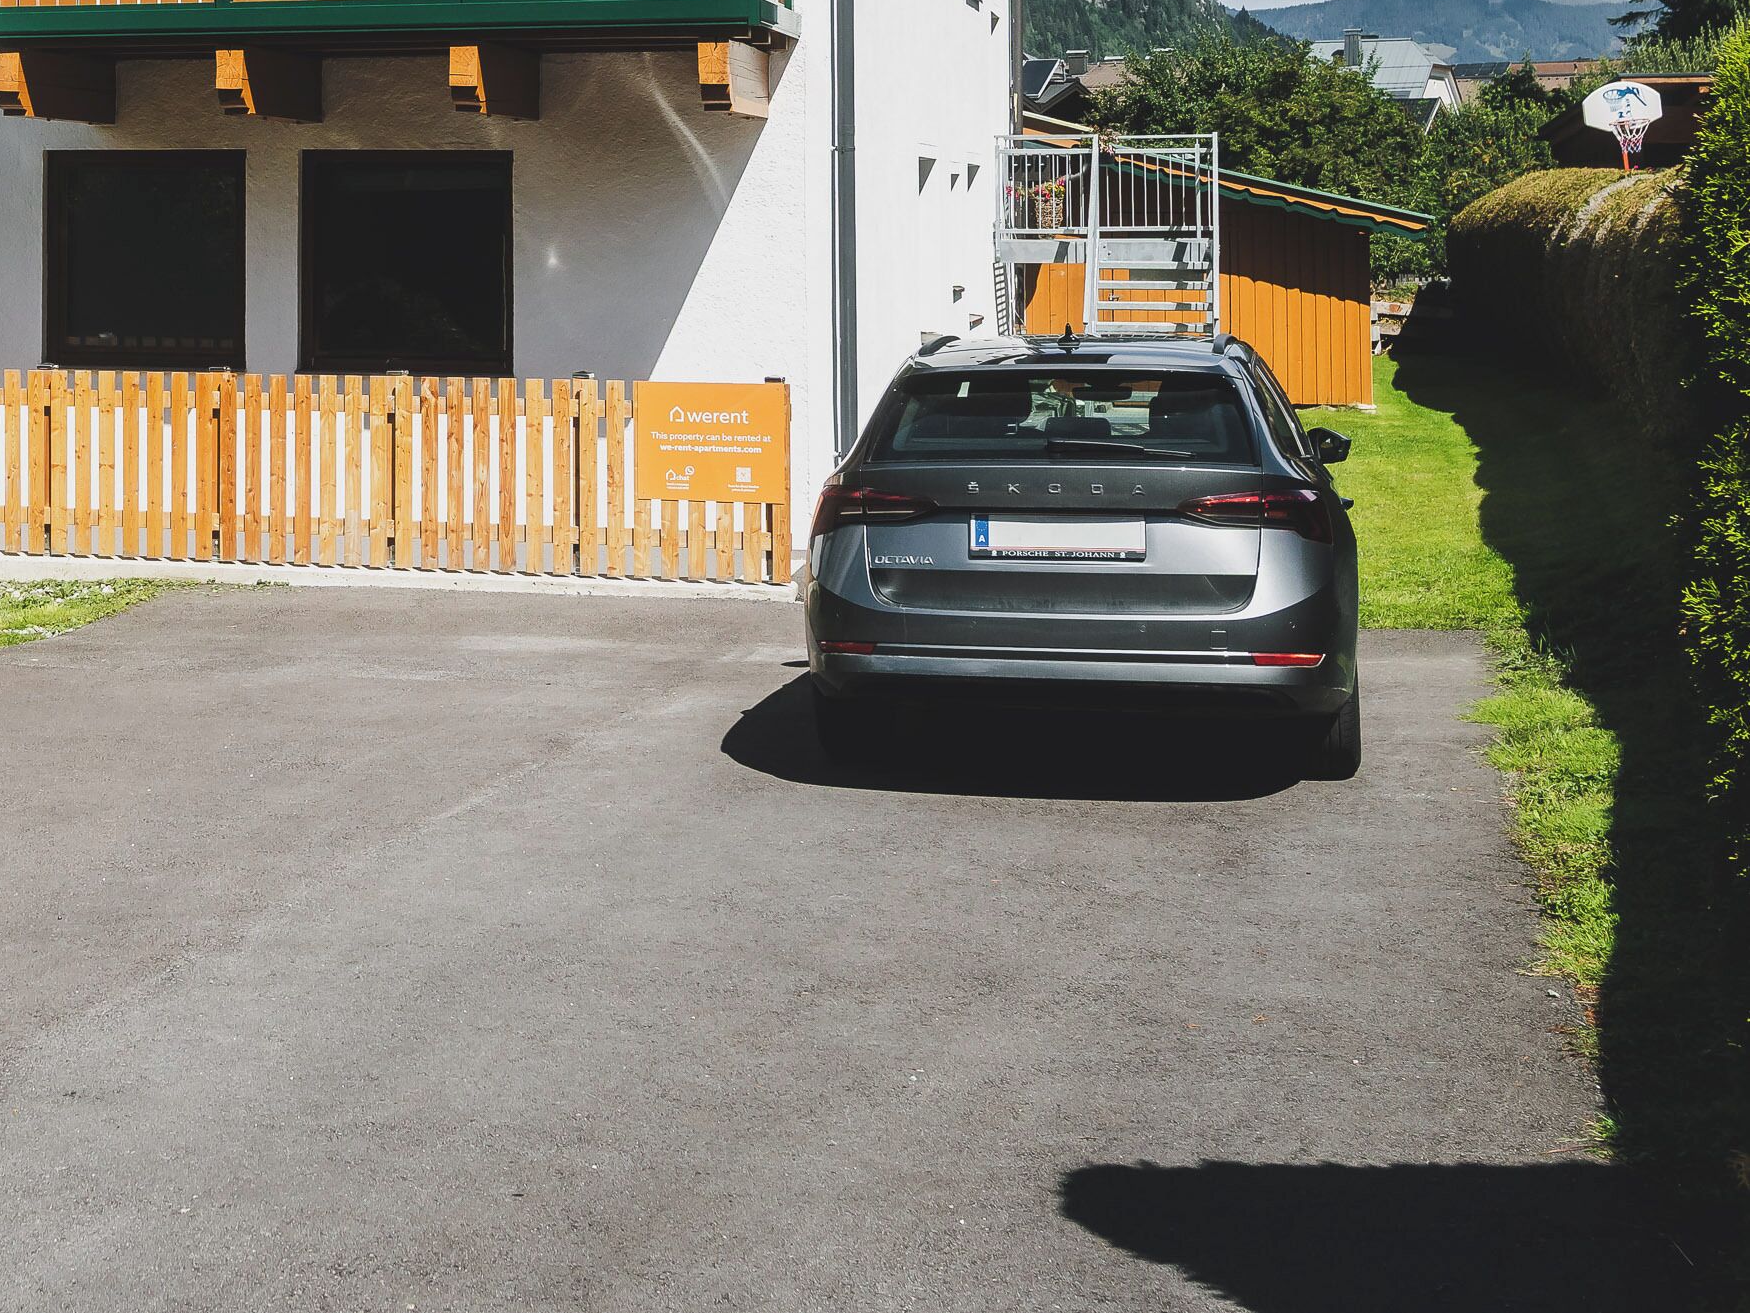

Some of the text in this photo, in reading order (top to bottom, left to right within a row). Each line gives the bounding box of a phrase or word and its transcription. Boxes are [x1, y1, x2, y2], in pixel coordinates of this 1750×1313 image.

[687, 410, 749, 424] werent
[651, 431, 667, 440] This
[669, 432, 704, 442] property
[722, 433, 732, 441] be
[734, 433, 761, 442] rented
[659, 444, 762, 453] we-rent-apartments.com
[967, 481, 1146, 497] ŠKODA
[978, 534, 986, 543] A
[1055, 550, 1069, 558] ST.
[874, 555, 934, 565] OCTAVIA
